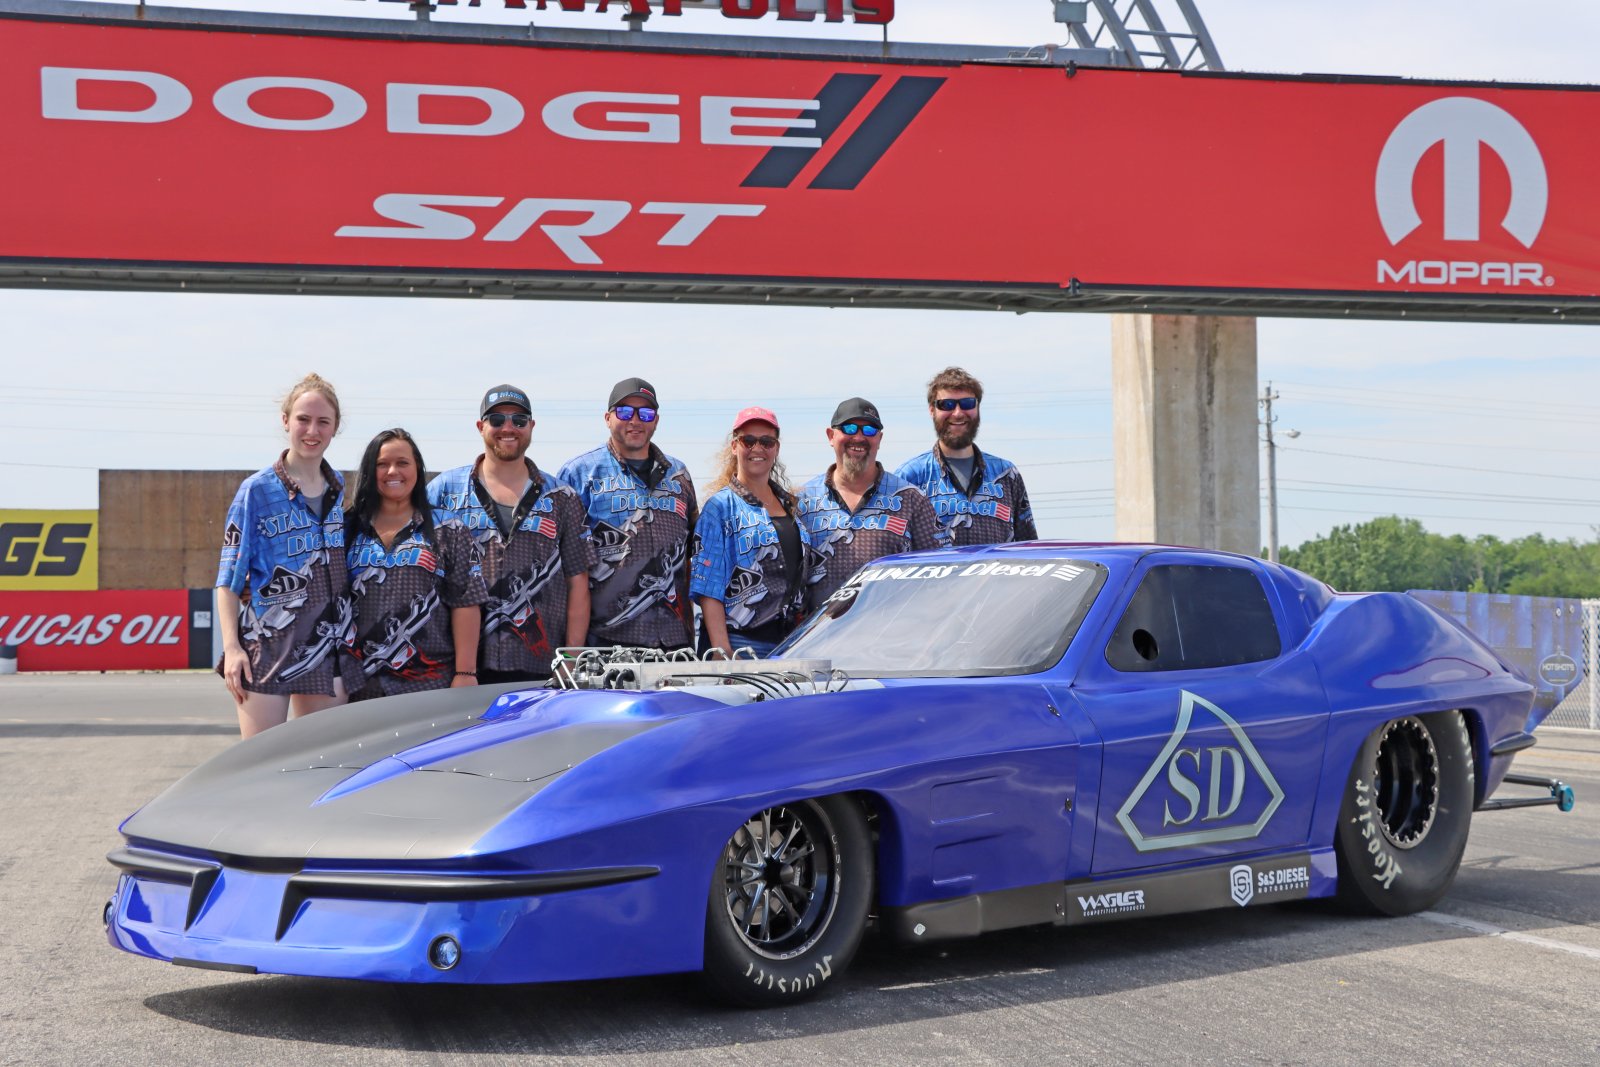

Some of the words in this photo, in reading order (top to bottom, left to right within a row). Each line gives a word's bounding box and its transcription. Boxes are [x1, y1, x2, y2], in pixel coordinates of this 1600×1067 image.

[41, 66, 822, 149] DODGE
[334, 193, 766, 265] SRT
[812, 513, 890, 533] Diesel
[958, 562, 1057, 577] Diesel
[268, 575, 300, 596] SD
[730, 571, 753, 597] SD
[120, 614, 183, 645] OIL
[1163, 747, 1246, 828] SD
[1257, 870, 1275, 887] S&S
[1276, 866, 1309, 885] DIESEL
[1077, 889, 1145, 911] WAGLER
